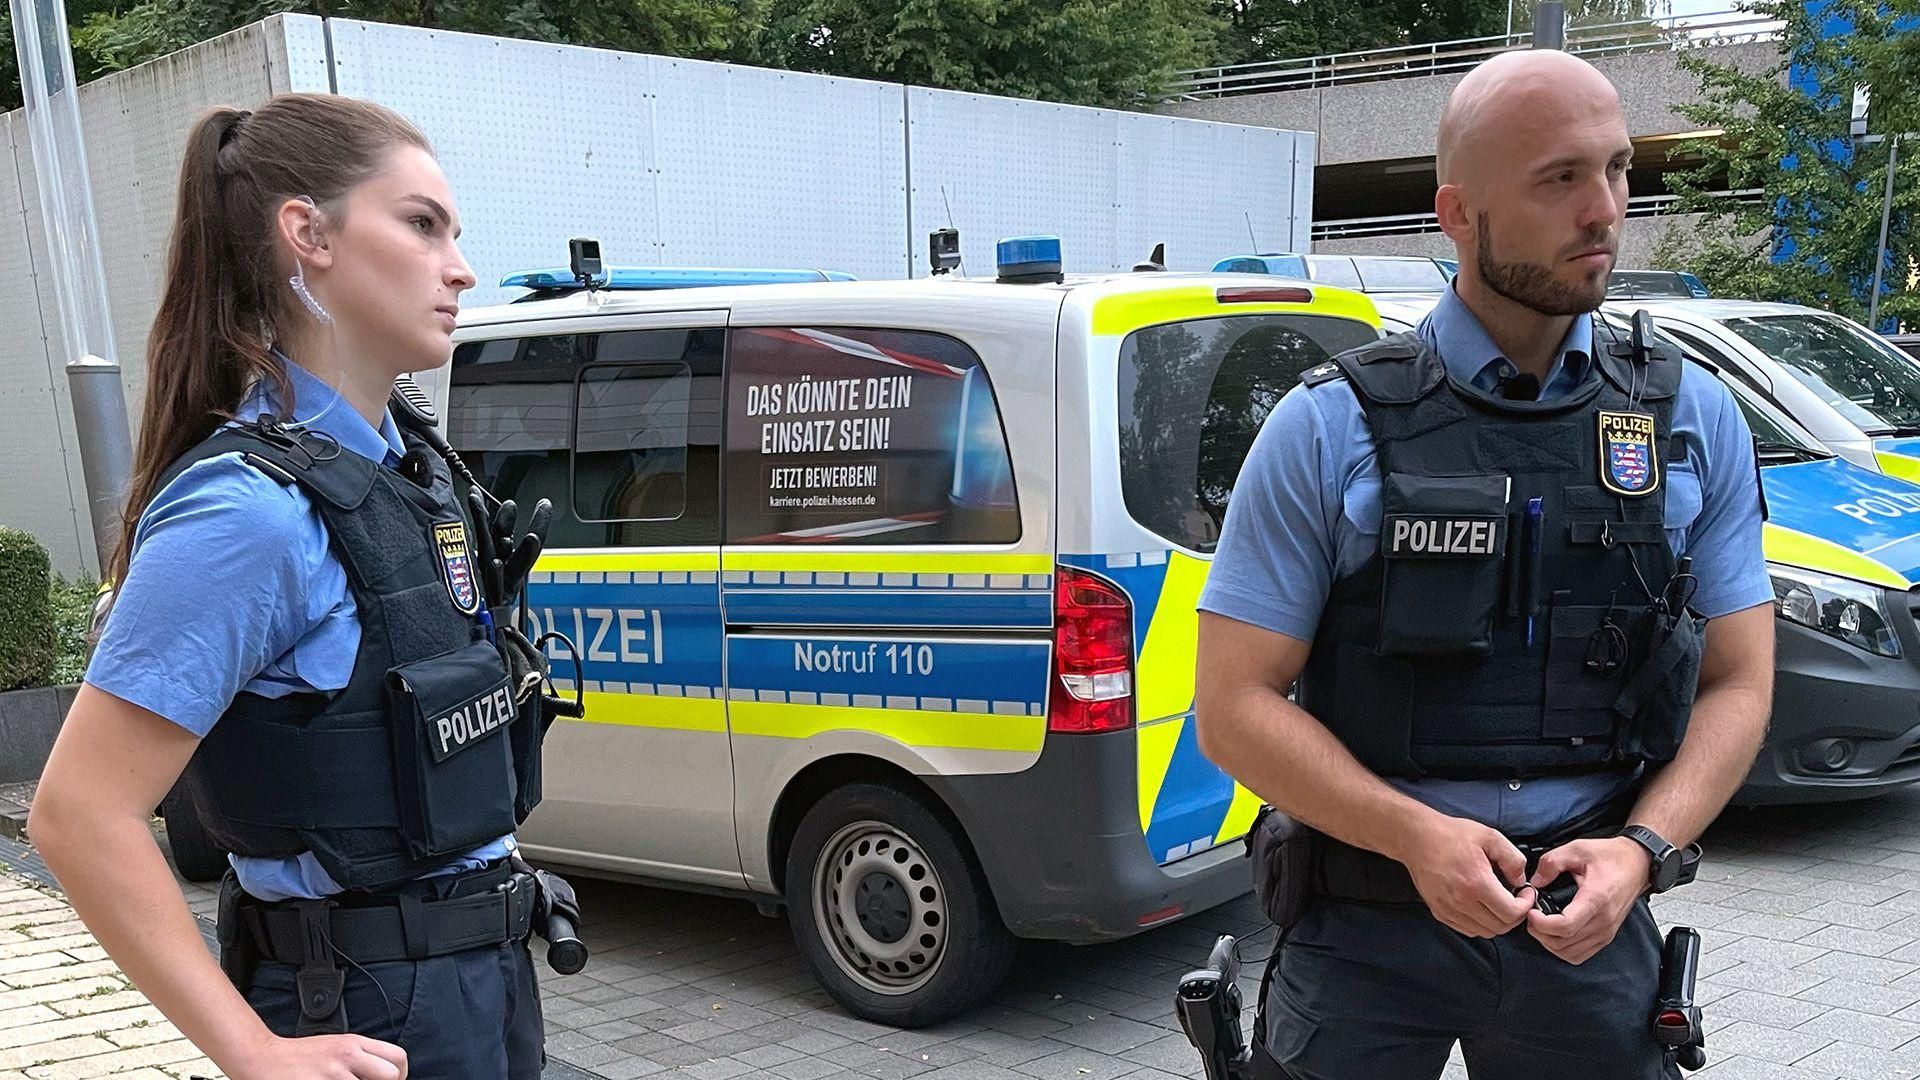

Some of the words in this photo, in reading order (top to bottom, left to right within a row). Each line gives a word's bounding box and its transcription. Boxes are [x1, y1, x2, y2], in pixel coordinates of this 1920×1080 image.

[747, 384, 782, 416] DAS
[786, 375, 861, 414] KÖNNTE
[865, 376, 912, 410] DEIN
[761, 420, 836, 454] EINSATZ
[839, 417, 890, 451] SEIN!
[1602, 415, 1651, 434] POLIZEI
[769, 468, 803, 489] JETZT
[805, 465, 877, 488] BEWERBEN!
[769, 494, 876, 508] karriere.polizei.hessen.de
[1393, 520, 1496, 554] POLIZEI
[511, 606, 663, 664] OLIZEI
[795, 642, 877, 673] Notruf
[886, 644, 934, 676] 110
[437, 685, 514, 753] POLIZEI
